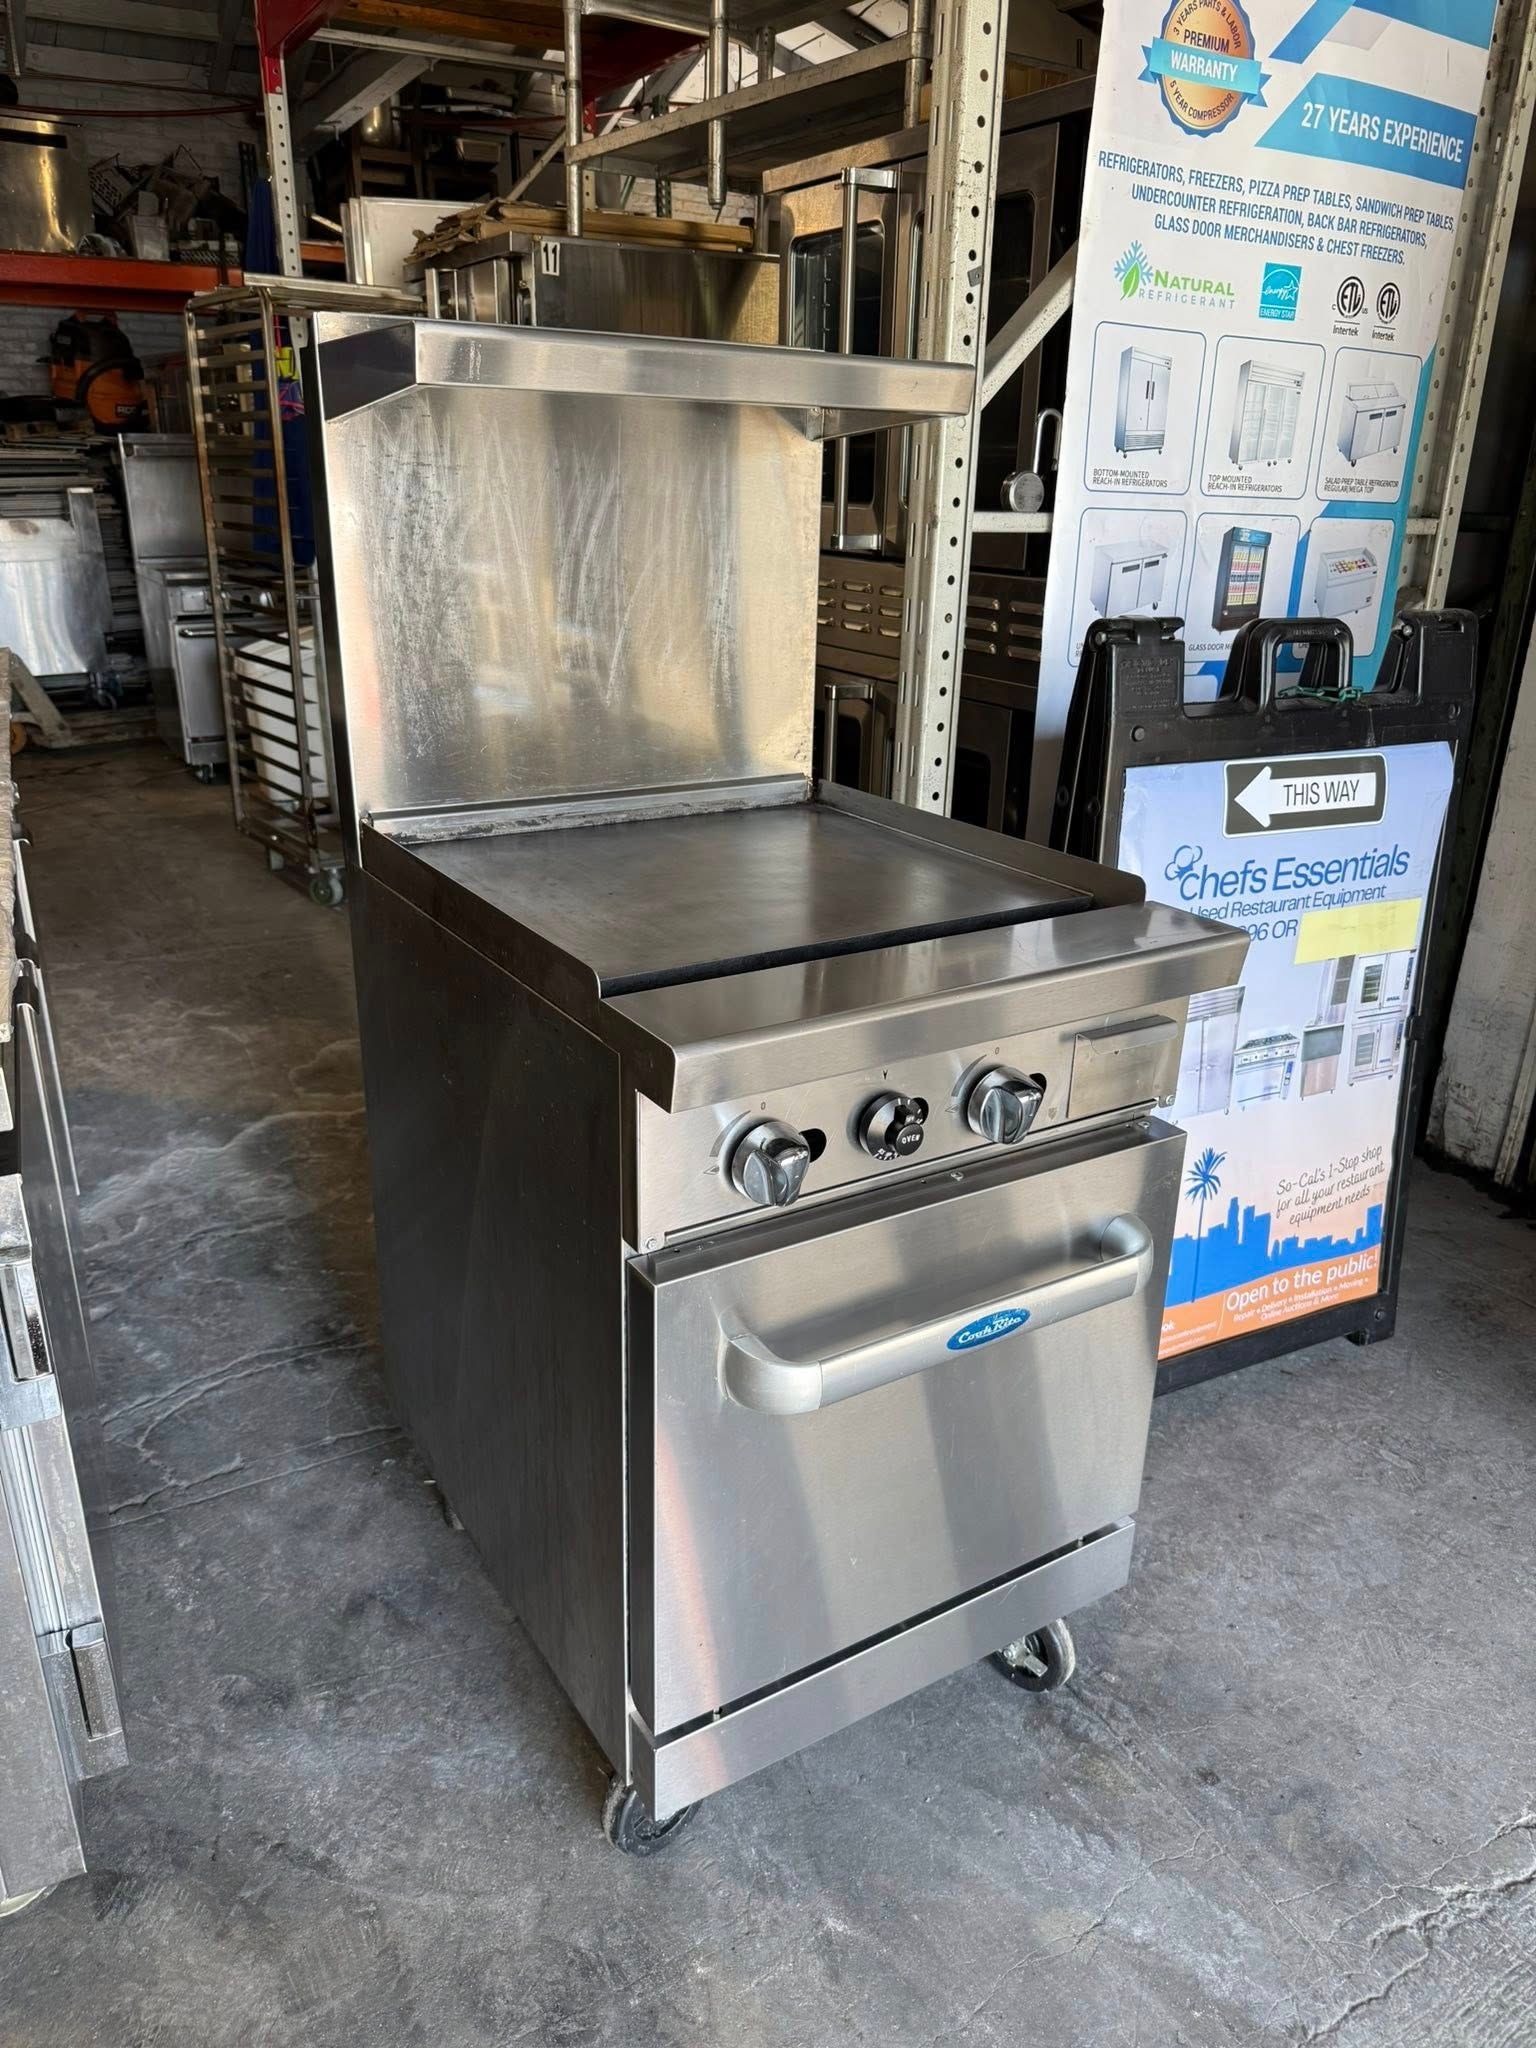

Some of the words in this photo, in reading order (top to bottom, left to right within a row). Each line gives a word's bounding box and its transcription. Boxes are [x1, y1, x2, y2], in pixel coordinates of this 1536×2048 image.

[1176, 2, 1198, 26] YEARS
[1199, 0, 1222, 12] PARTS
[1221, 7, 1227, 16] &
[1173, 27, 1180, 36] 3
[1183, 29, 1230, 53] PREMIUM
[1225, 14, 1242, 49] LABOR
[1171, 49, 1239, 82] WARRANTY
[1172, 87, 1189, 112] YEAR
[1187, 92, 1235, 121] COMPRESSOR
[1301, 101, 1325, 129] 27
[1328, 105, 1381, 141] YEARS
[1382, 118, 1465, 164] EXPERIENCE
[1098, 150, 1186, 187] REFRIGERATORS,
[1188, 169, 1246, 196] FREEZERS,
[1248, 179, 1281, 198] PIZZA
[1283, 184, 1311, 202] PREP
[1313, 189, 1353, 212] TABLES,
[1355, 196, 1403, 219] SANDWICH
[1404, 206, 1424, 223] PREP
[1426, 211, 1455, 234] TABLES,
[1131, 183, 1216, 214] UNDERCOUNTER
[1218, 199, 1305, 229] REFRIGERATION,
[1307, 212, 1336, 231] BACK
[1337, 216, 1357, 234] BAR
[1359, 220, 1428, 250] REFRIGERATORS,
[1154, 213, 1190, 234] GLASS
[1192, 219, 1222, 239] DOOR
[1224, 224, 1315, 251] MERCHANDISERS
[1316, 237, 1325, 252] &
[1326, 238, 1359, 258] CHEST
[1360, 243, 1406, 265] FREEZERS.
[543, 243, 558, 273] 11
[1154, 269, 1236, 296] NATURAL
[1138, 288, 1236, 310] REFRIGERANT
[1260, 307, 1281, 318] ENERGY
[1281, 309, 1296, 320] STAR
[1332, 324, 1360, 337] Intertek
[1371, 329, 1395, 342] Intertek
[1121, 478, 1168, 488] REFRIGERATORS
[1237, 483, 1283, 493] REFRIGERATORS
[1188, 643, 1207, 652] GLASS
[1207, 643, 1224, 651] DOOR
[1283, 781, 1320, 807] THIS
[1323, 779, 1360, 804] WAY
[1272, 843, 1411, 891] Essentials
[1230, 893, 1311, 919] Restaurant
[1312, 885, 1387, 910] Equipment
[1272, 919, 1299, 939] OR
[901, 1134, 921, 1144] OVEN
[1276, 1167, 1326, 1196] So-Cal's
[1328, 1155, 1359, 1179] 1-Stop
[1361, 1145, 1383, 1163] shop
[1275, 1198, 1292, 1219] for
[1294, 1188, 1311, 1206] all
[1311, 1183, 1336, 1206] your
[1336, 1161, 1386, 1192] restaurant
[1289, 1197, 1343, 1228] equipment
[1344, 1184, 1371, 1206] needs
[1226, 1284, 1268, 1312] Open
[1272, 1277, 1290, 1296] to
[1293, 1269, 1323, 1289] the
[1326, 1248, 1379, 1281] public!
[1339, 1278, 1364, 1290] Moving
